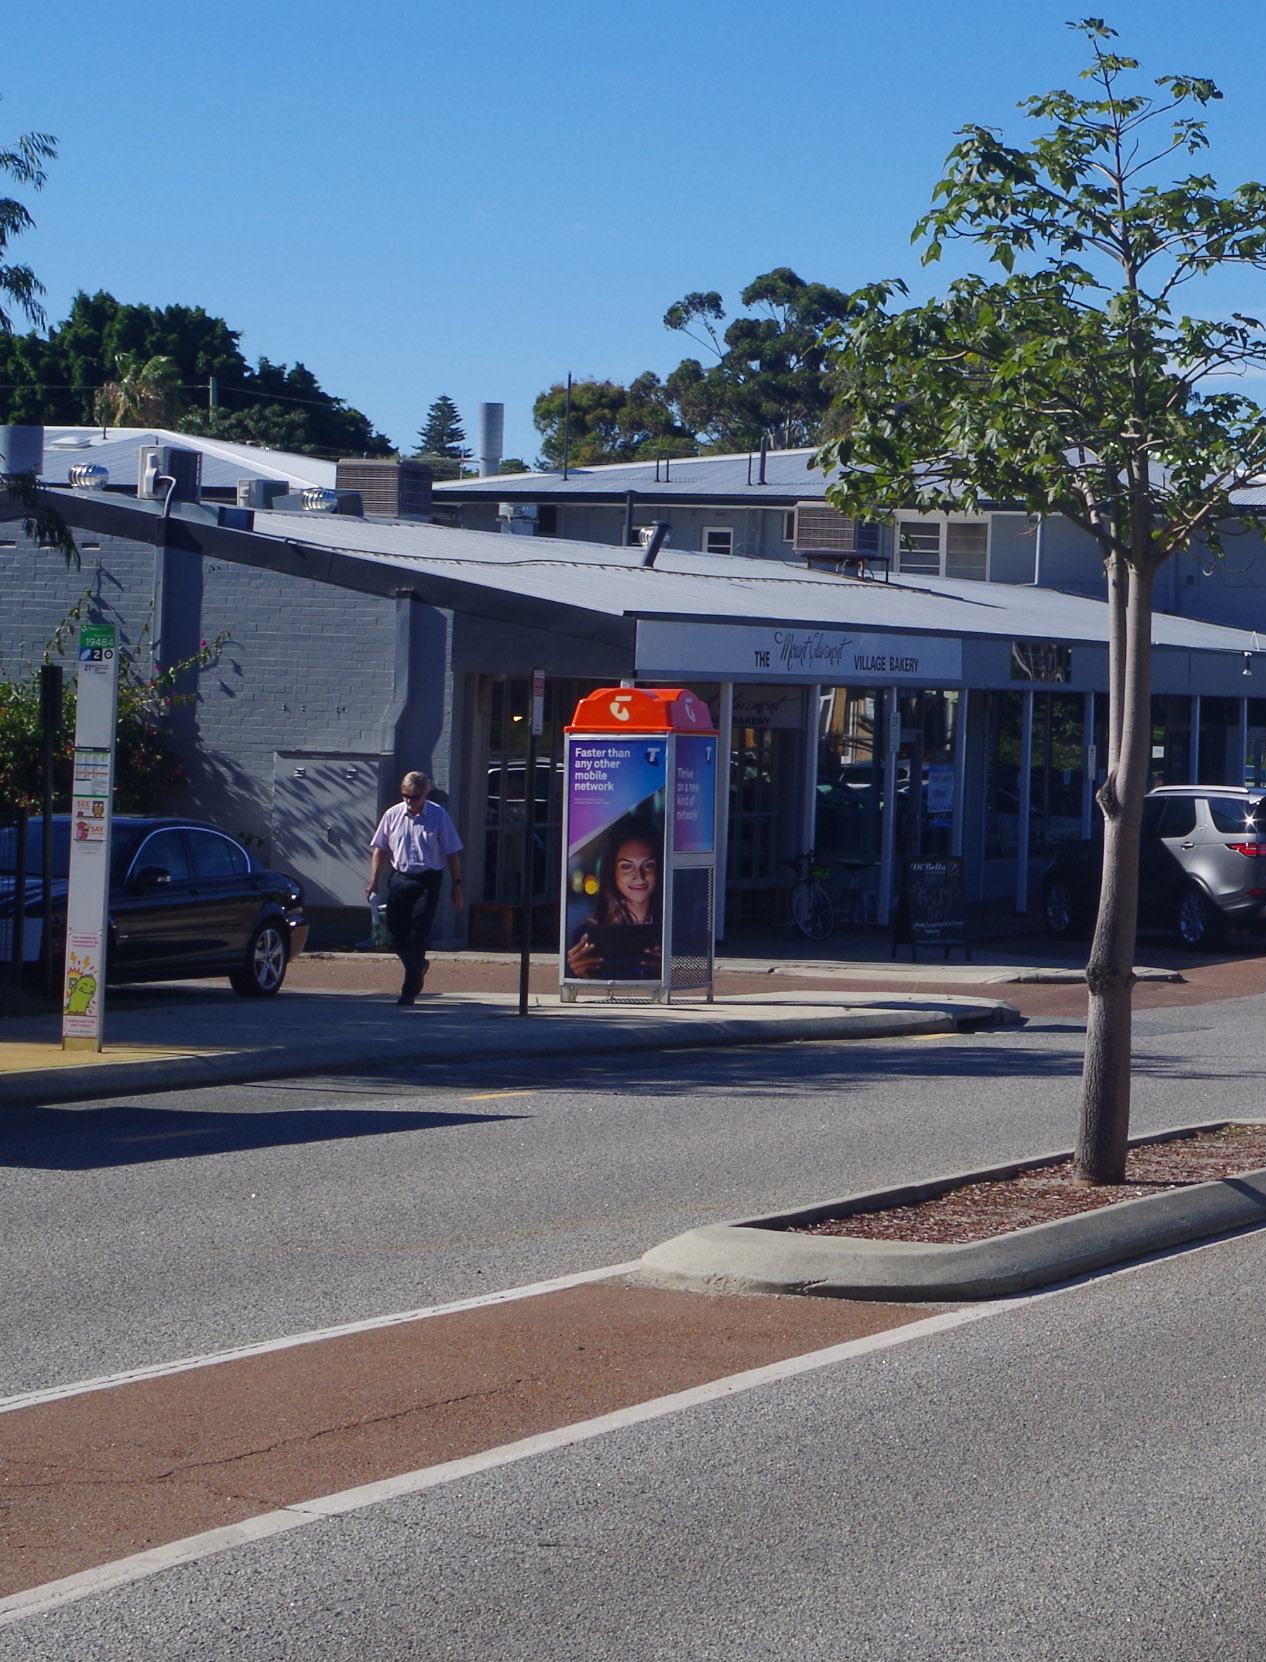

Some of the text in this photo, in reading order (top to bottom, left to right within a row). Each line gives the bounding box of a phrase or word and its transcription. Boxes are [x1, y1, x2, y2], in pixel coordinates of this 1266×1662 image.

[86, 638, 114, 647] 19484
[93, 649, 101, 659] 2
[754, 650, 770, 668] THE
[853, 655, 886, 671] VILLAGE
[889, 656, 920, 673] BAKERY
[575, 747, 631, 758] Faster than
[574, 759, 621, 770] any other
[574, 770, 607, 780] mobile
[677, 767, 694, 779] Thrive
[574, 781, 614, 791] network
[677, 783, 684, 792] on
[690, 783, 700, 792] new
[677, 794, 689, 806] kind
[677, 810, 698, 820] network
